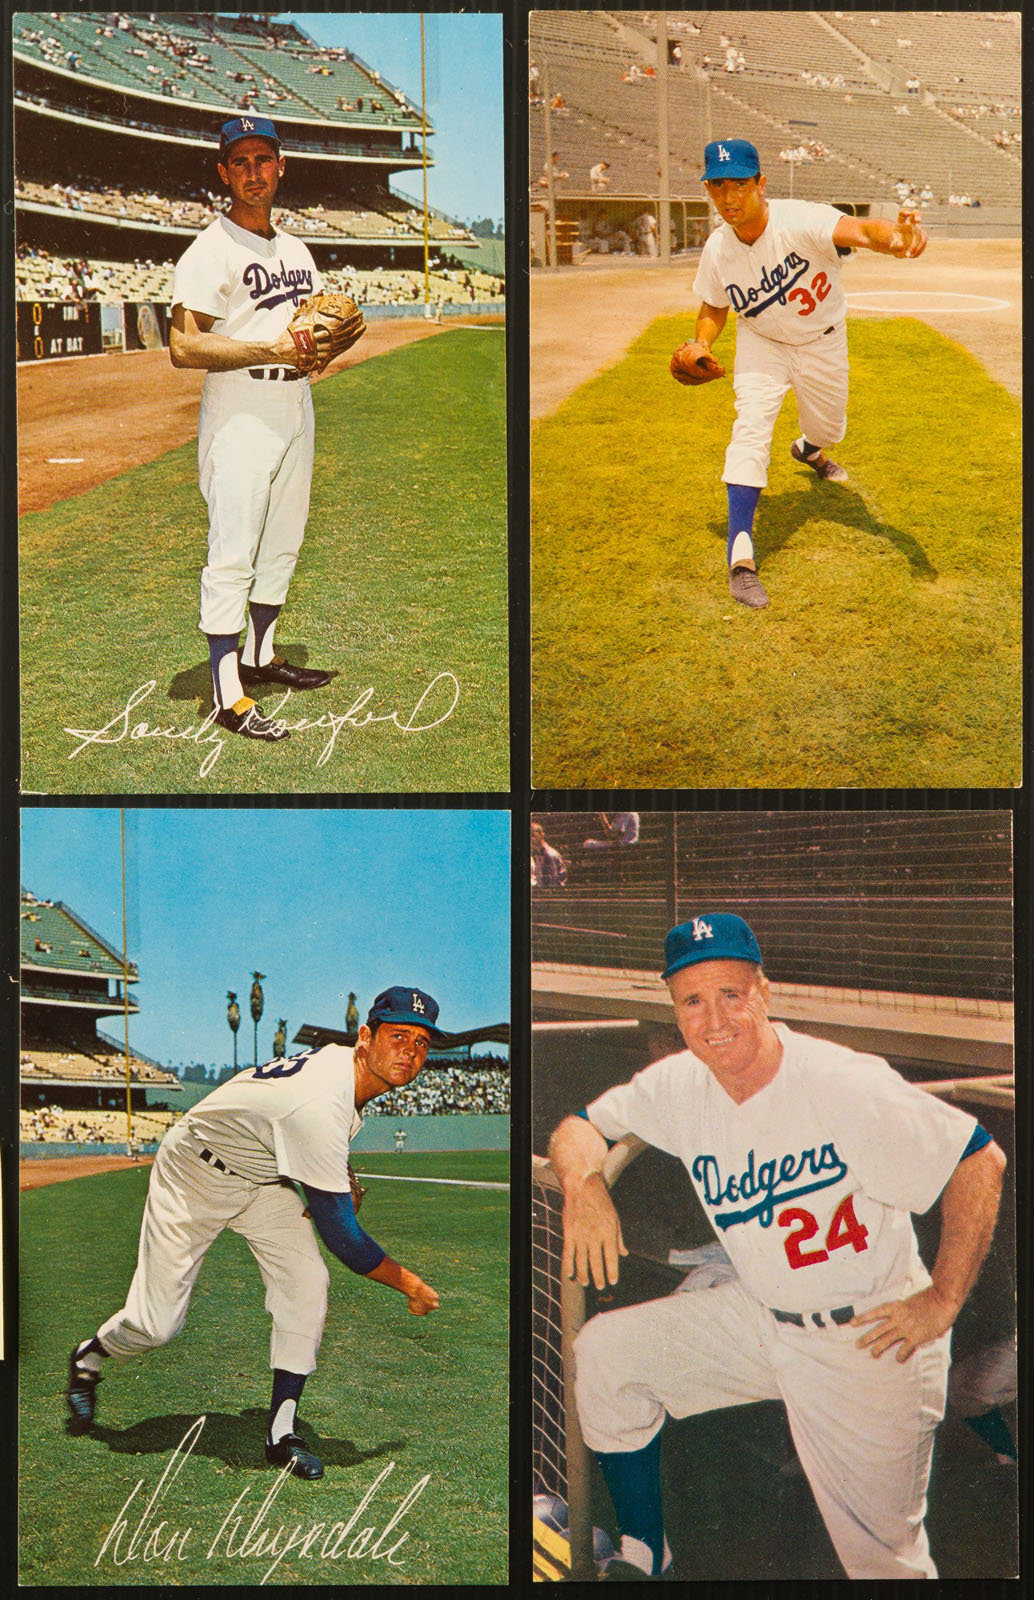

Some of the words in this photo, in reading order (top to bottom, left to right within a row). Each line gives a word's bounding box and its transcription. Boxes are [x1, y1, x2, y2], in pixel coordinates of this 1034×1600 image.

[241, 117, 255, 132] LA
[718, 144, 731, 162] LA
[242, 259, 313, 311] Dodgers
[725, 251, 810, 318] Dodgers
[788, 271, 832, 316] 32
[50, 338, 63, 354] AT
[64, 679, 227, 778] Sandy
[692, 916, 714, 941] LA
[412, 993, 425, 1014] LA
[692, 1142, 848, 1232] Dodgers
[777, 1191, 869, 1270] 24
[94, 1415, 207, 1568] Don
